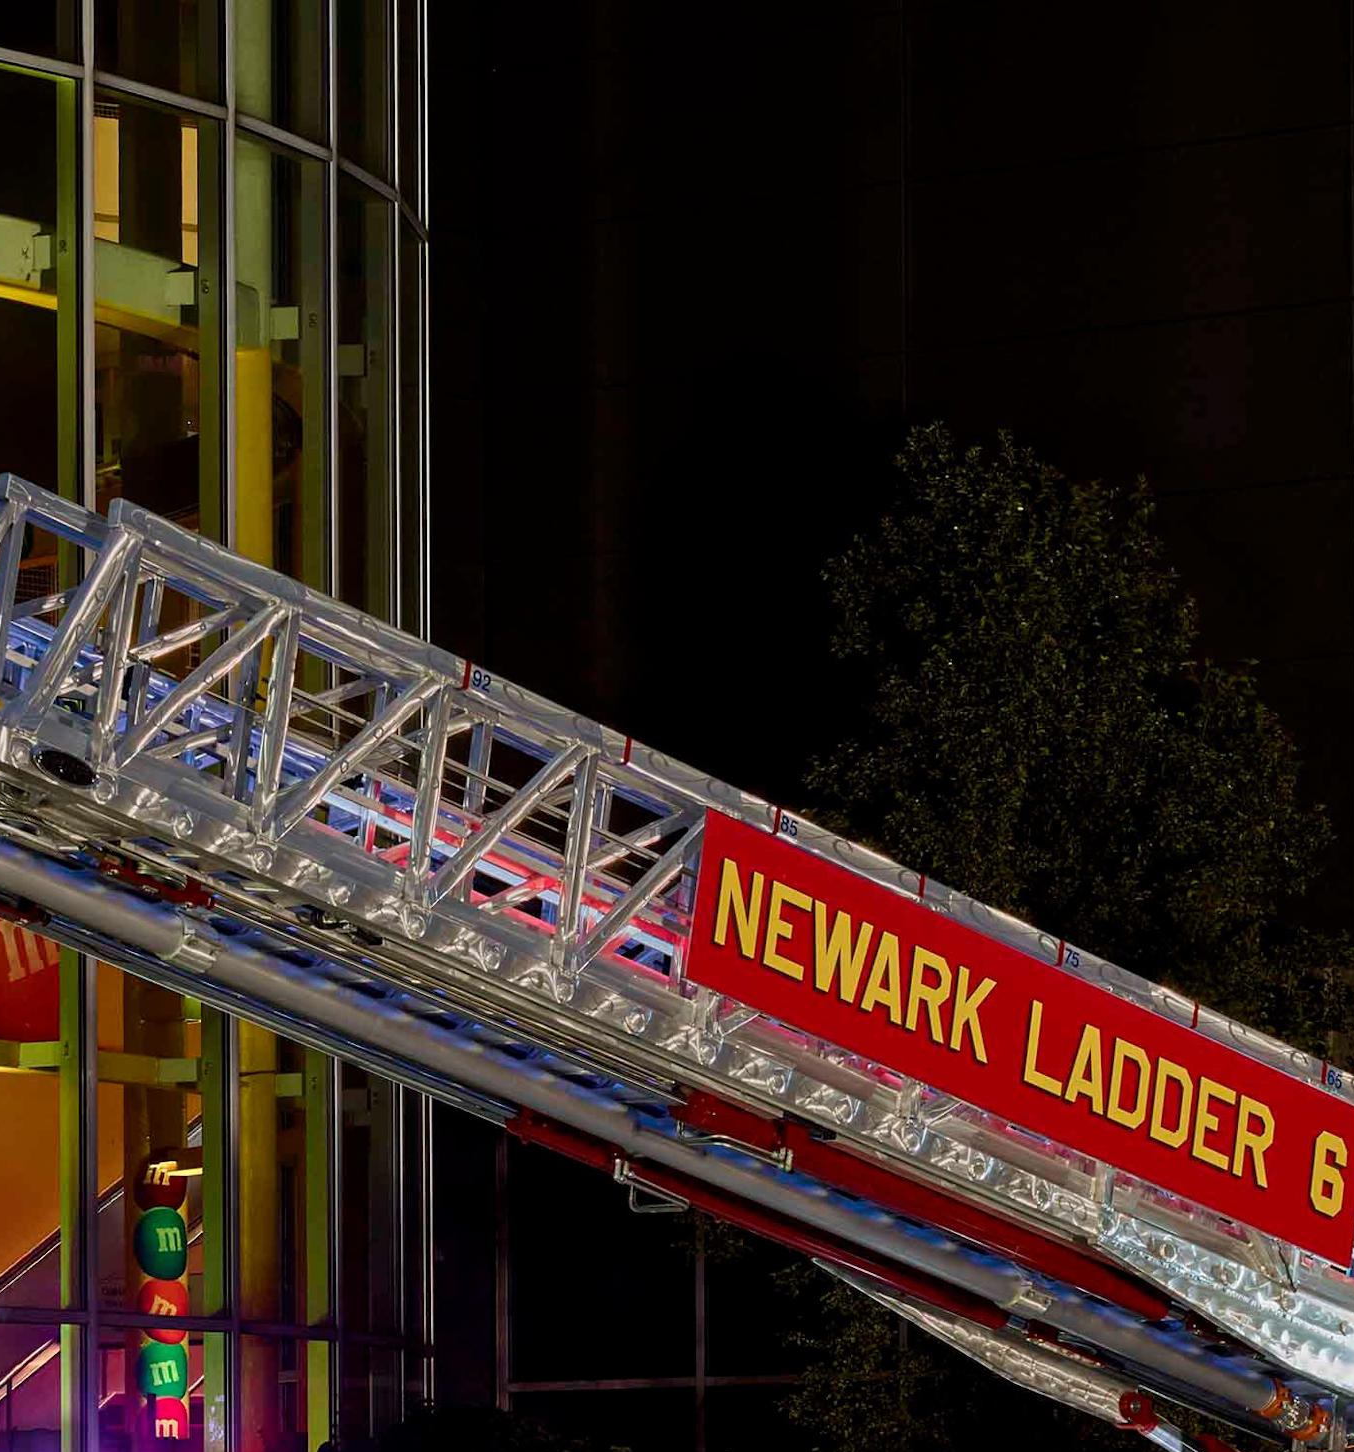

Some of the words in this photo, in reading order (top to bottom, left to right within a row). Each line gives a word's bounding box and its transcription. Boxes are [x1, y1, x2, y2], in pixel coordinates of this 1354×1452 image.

[473, 670, 491, 692] 92
[781, 815, 798, 836] 85
[1066, 948, 1079, 967] 75
[714, 857, 997, 1065] NEWARK
[1023, 999, 1276, 1189] LADDER
[1309, 1130, 1349, 1217] 6
[1328, 1070, 1341, 1088] 65
[156, 1227, 182, 1252] m
[150, 1360, 178, 1386] m
